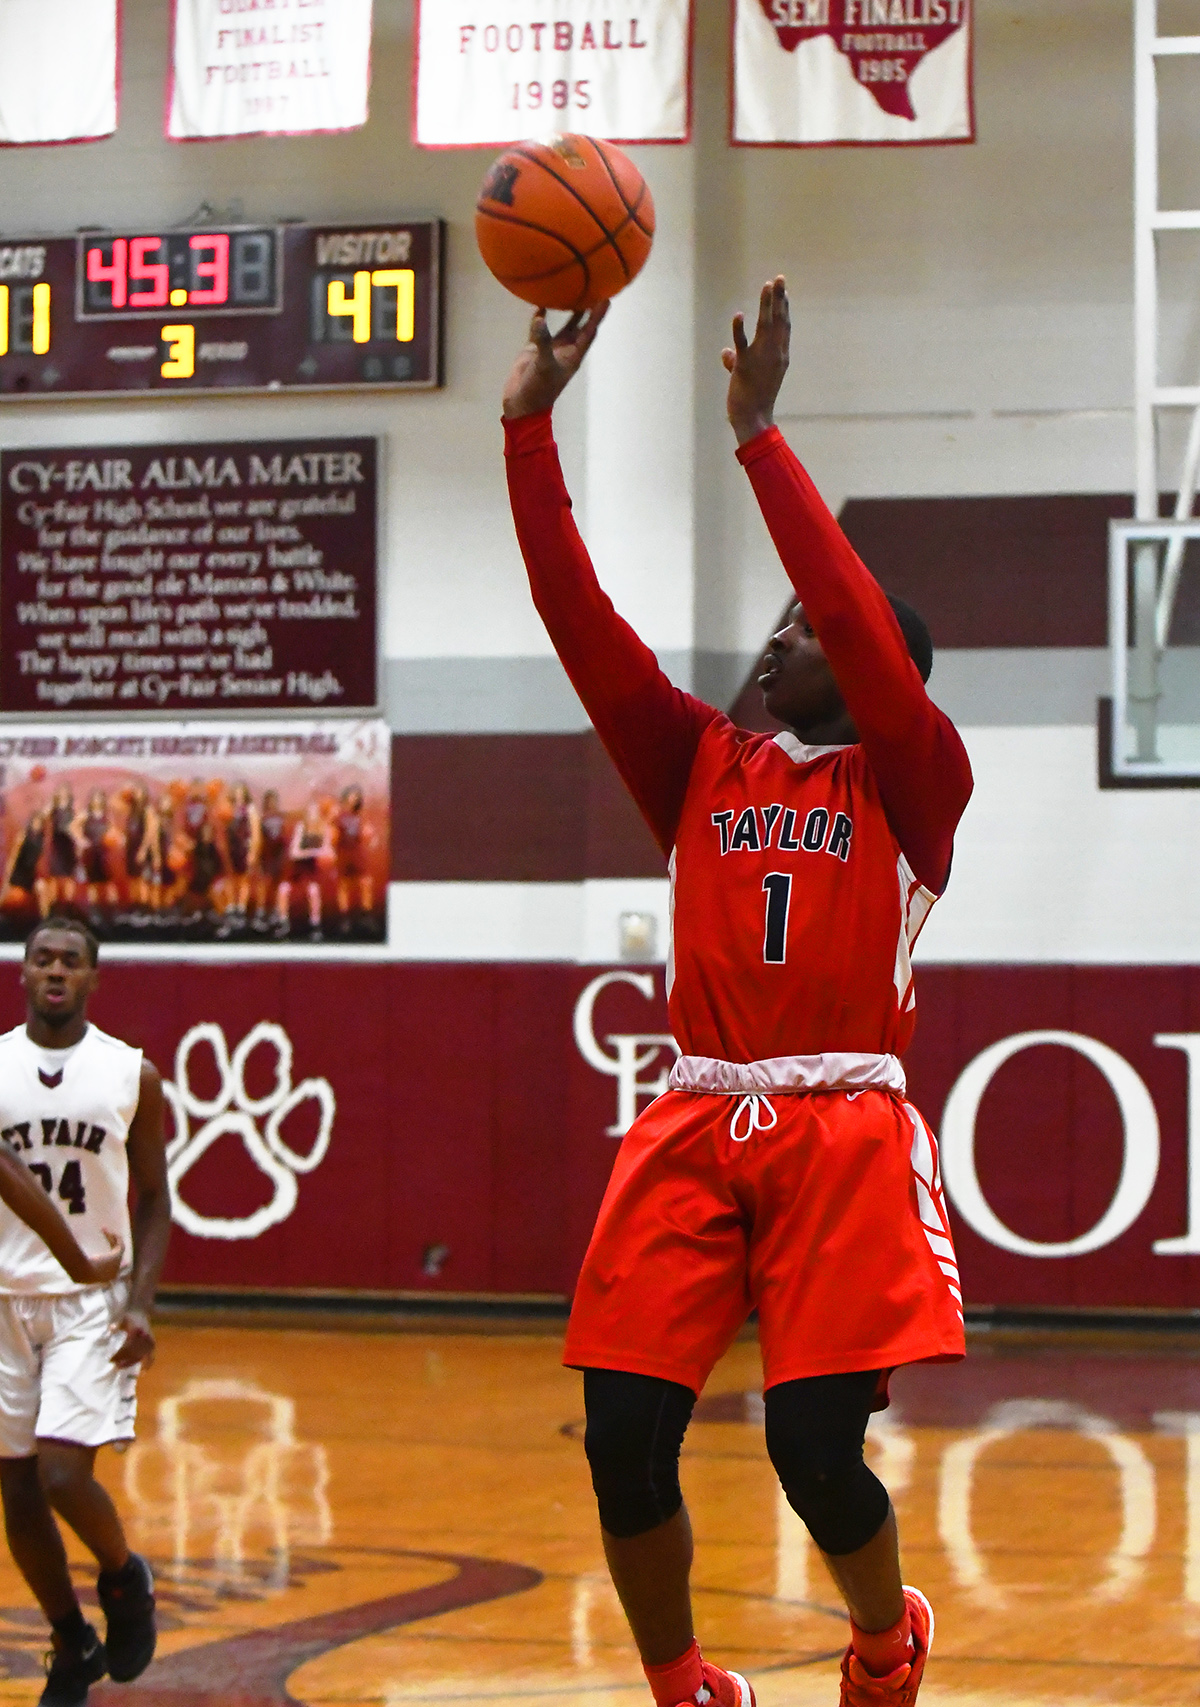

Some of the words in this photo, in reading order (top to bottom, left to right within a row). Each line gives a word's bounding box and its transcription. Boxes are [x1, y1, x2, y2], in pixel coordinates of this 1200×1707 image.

[771, 0, 829, 27] SEMI
[844, 0, 961, 26] FINALIST
[218, 22, 325, 49] FINALIST
[459, 18, 648, 53] FOOTBALL
[842, 33, 927, 51] FOOTBALL
[205, 58, 331, 85] FOOTBALL
[859, 59, 908, 82] 1985
[511, 79, 594, 110] 1985
[317, 230, 411, 266] VISITOR
[87, 234, 230, 308] 45.3
[327, 269, 415, 344] 47
[161, 324, 195, 379] 3
[8, 459, 133, 494] CY-FAIR
[141, 456, 242, 489] ALMA
[249, 451, 365, 487] MATER
[93, 498, 143, 526] High
[213, 500, 242, 517] we
[245, 499, 276, 517] are
[278, 490, 356, 522] grateful
[38, 522, 66, 548] for
[69, 522, 100, 547] the
[104, 521, 190, 552] guidance
[191, 518, 214, 544] of
[216, 525, 250, 544] our
[17, 550, 50, 573] We
[52, 549, 98, 573] have
[100, 547, 164, 577] fought
[166, 553, 200, 570] our
[205, 552, 262, 576] every
[266, 543, 323, 568] battle
[37, 573, 66, 599] for
[68, 572, 100, 598] the
[103, 573, 153, 604] good
[188, 571, 268, 596] Maroon
[270, 571, 289, 594] &
[16, 600, 77, 625] When
[78, 605, 128, 628] upon
[175, 597, 221, 627] path
[37, 632, 66, 649] we
[68, 623, 105, 649] will
[107, 622, 161, 648] recall
[162, 622, 208, 647] with
[210, 627, 224, 646] a
[18, 650, 56, 675] The
[58, 650, 120, 681] happy
[121, 651, 176, 673] times
[178, 653, 232, 672] we've
[233, 643, 273, 671] had
[36, 678, 117, 705] together
[119, 676, 140, 699] at
[141, 672, 217, 705] Cy-Fair
[220, 671, 284, 698] Senior
[711, 803, 853, 862] TAYLOR
[761, 871, 793, 964] 1
[41, 1117, 107, 1155] FAIR
